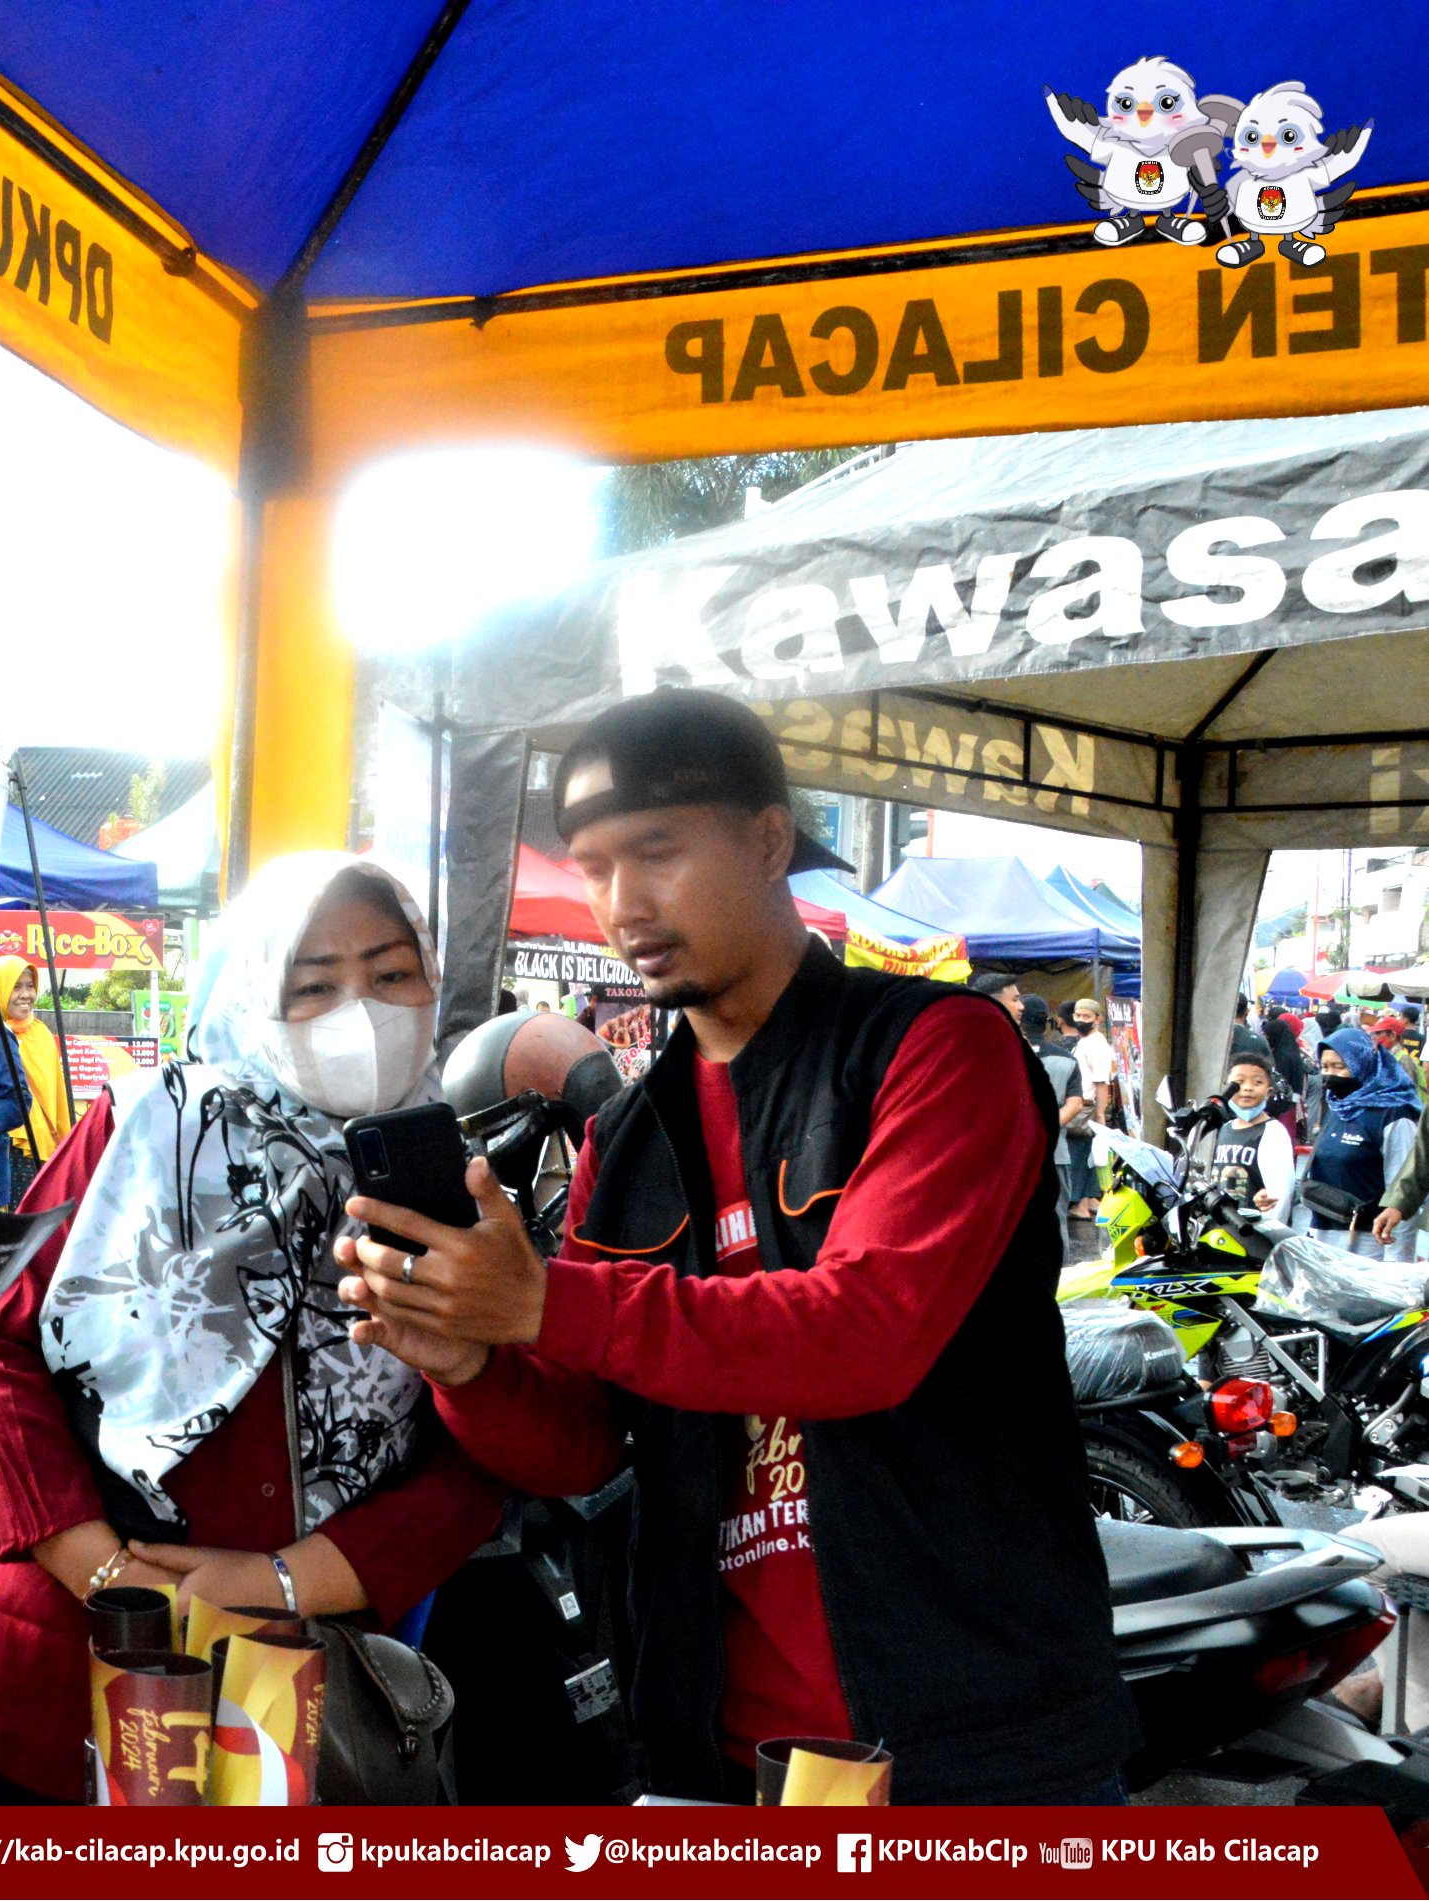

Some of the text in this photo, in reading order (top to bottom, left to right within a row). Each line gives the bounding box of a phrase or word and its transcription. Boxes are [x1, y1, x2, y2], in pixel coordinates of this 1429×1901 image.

[515, 951, 558, 979] BLACK
[561, 955, 574, 981] IS
[1133, 1279, 1216, 1299] KLX
[769, 1461, 805, 1501] 20
[118, 1718, 142, 1771] 2024
[126, 1707, 170, 1797] februari
